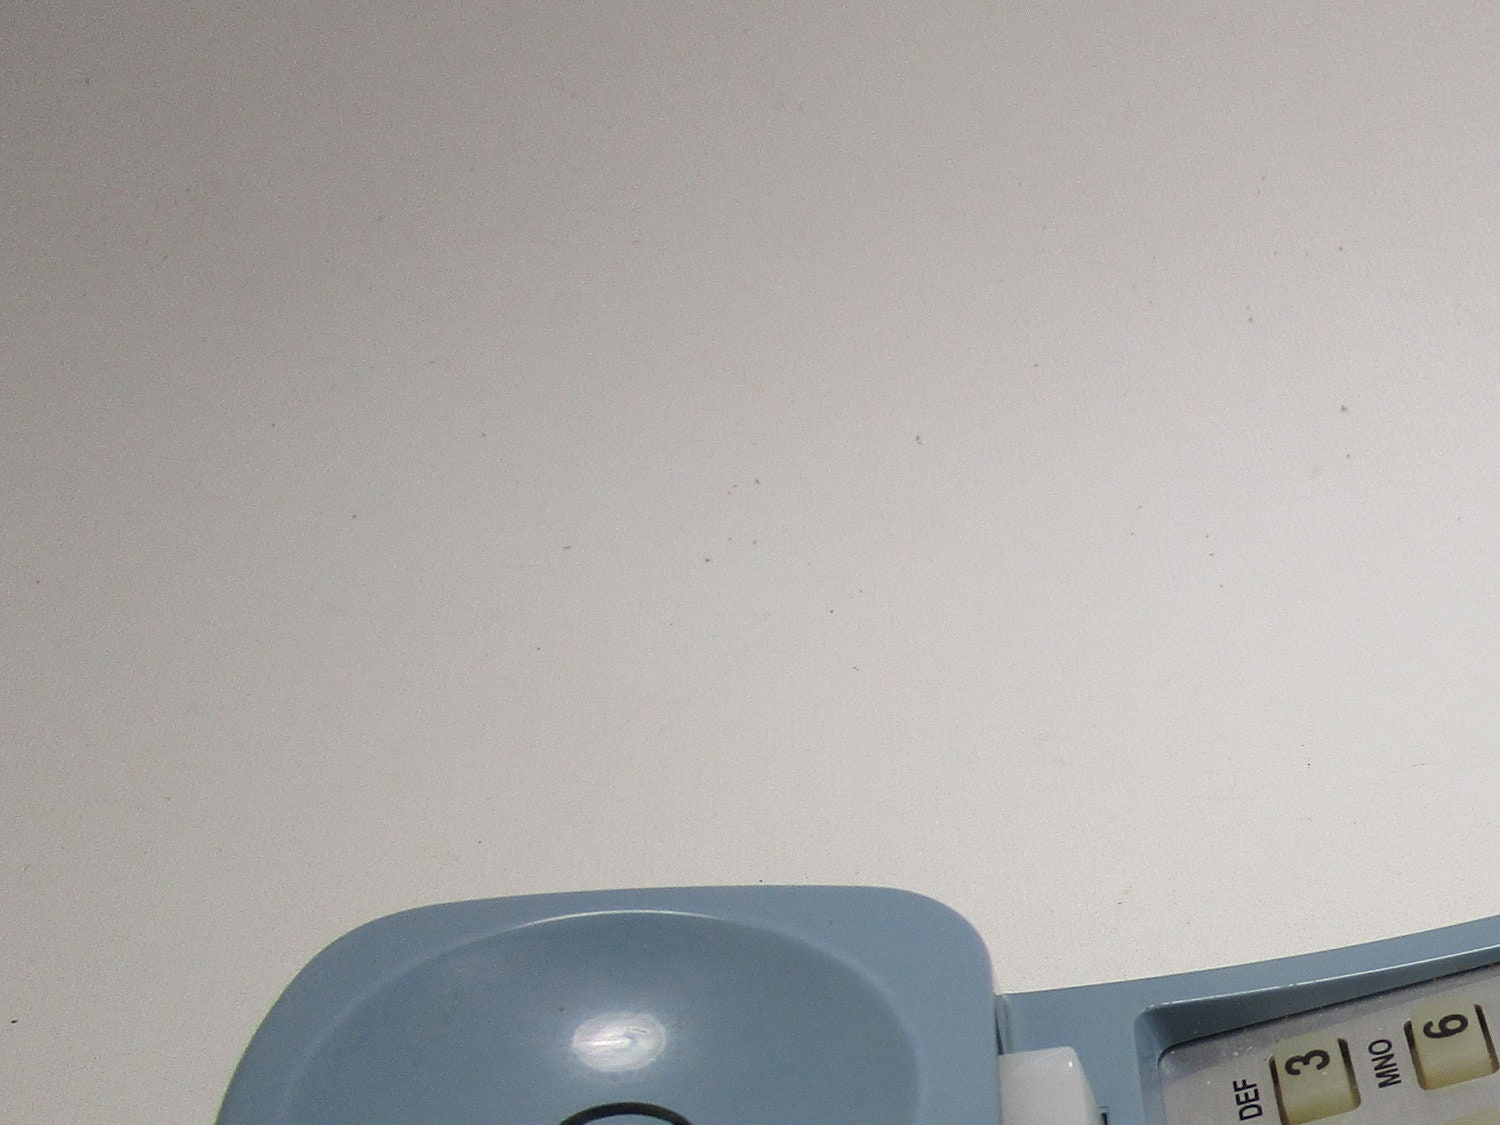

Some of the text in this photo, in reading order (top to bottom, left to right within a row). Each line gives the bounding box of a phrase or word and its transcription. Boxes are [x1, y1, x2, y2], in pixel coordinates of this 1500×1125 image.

[1423, 1014, 1468, 1039] 6
[1285, 1049, 1330, 1076] 3
[1368, 1039, 1401, 1088] MNO
[1233, 1079, 1263, 1121] DEF
